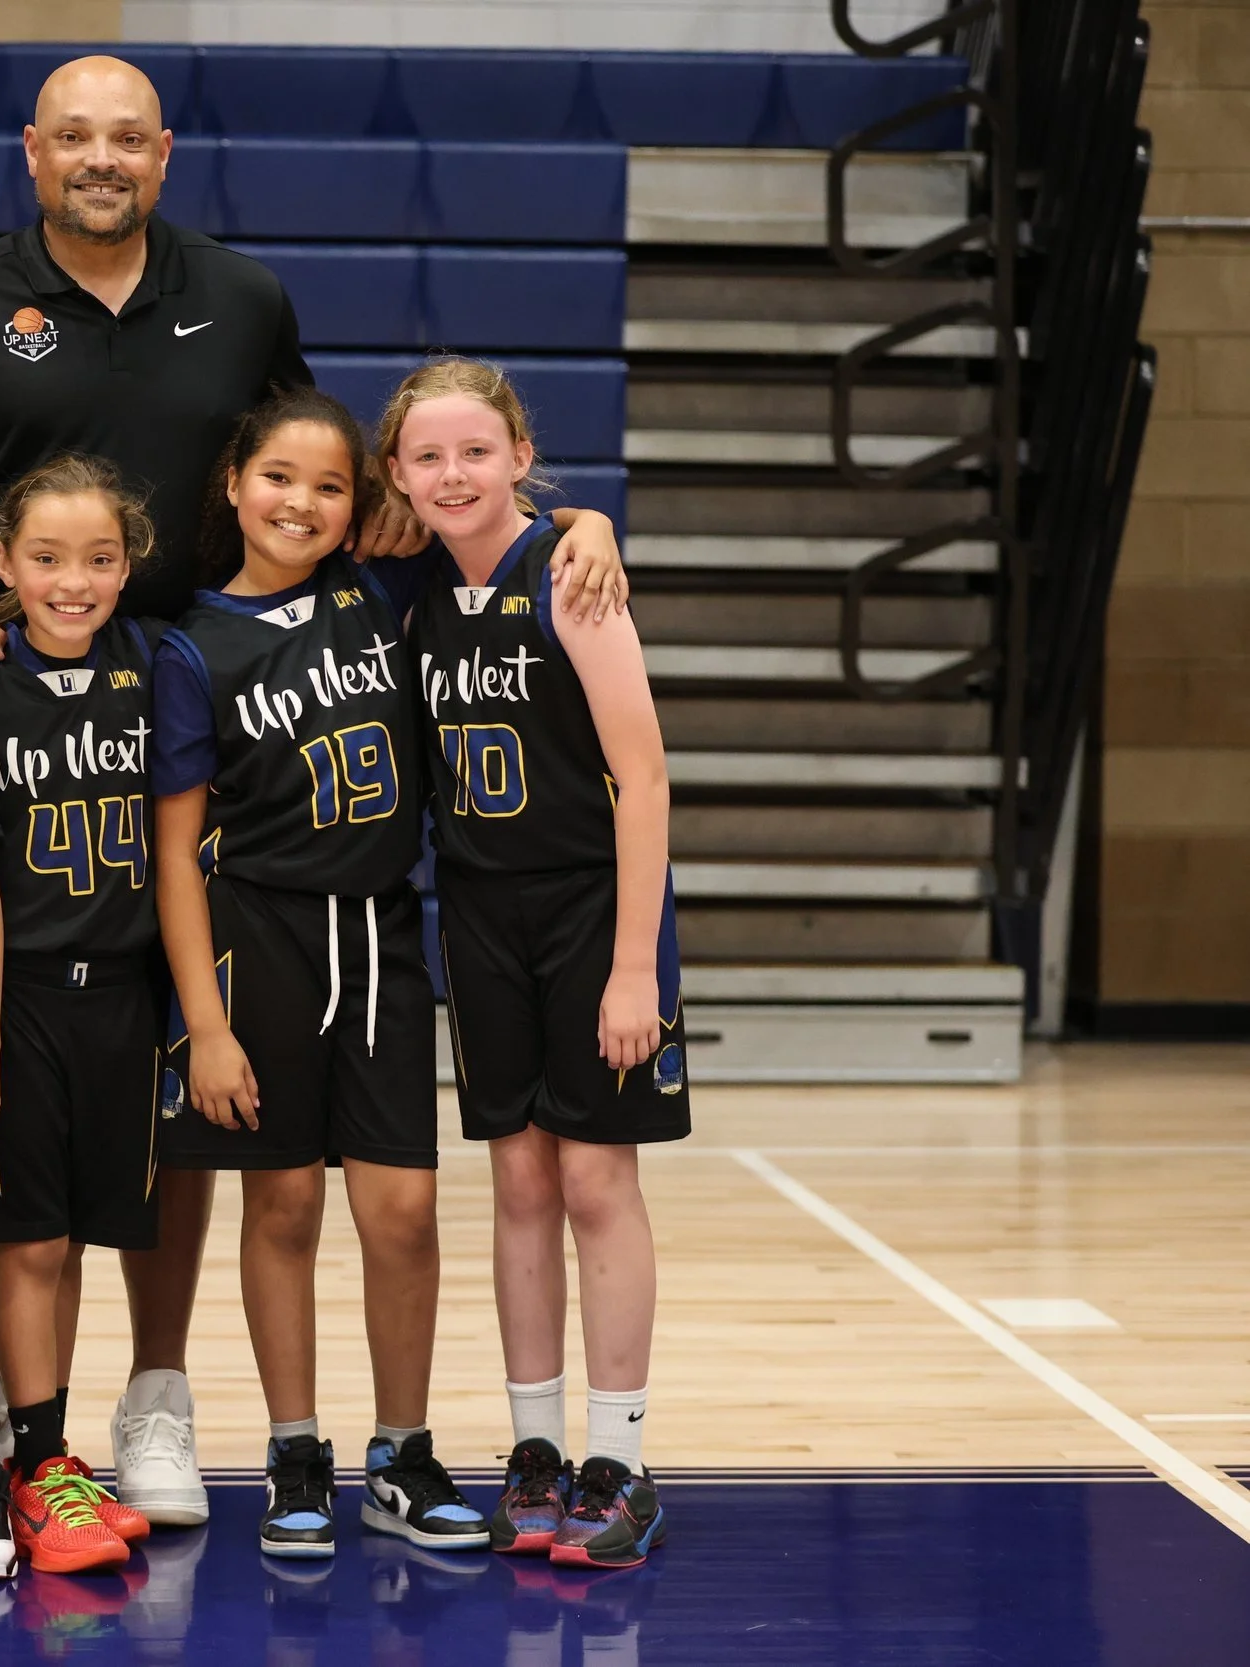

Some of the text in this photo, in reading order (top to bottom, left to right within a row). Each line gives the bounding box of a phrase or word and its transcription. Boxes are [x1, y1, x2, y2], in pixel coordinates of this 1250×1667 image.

[3, 330, 60, 346] UP NEXT
[235, 633, 398, 740] Up Next
[457, 645, 545, 705] Next
[65, 716, 152, 780] Next
[299, 721, 399, 829] 19
[438, 723, 528, 818] 10
[25, 794, 148, 896] 44
